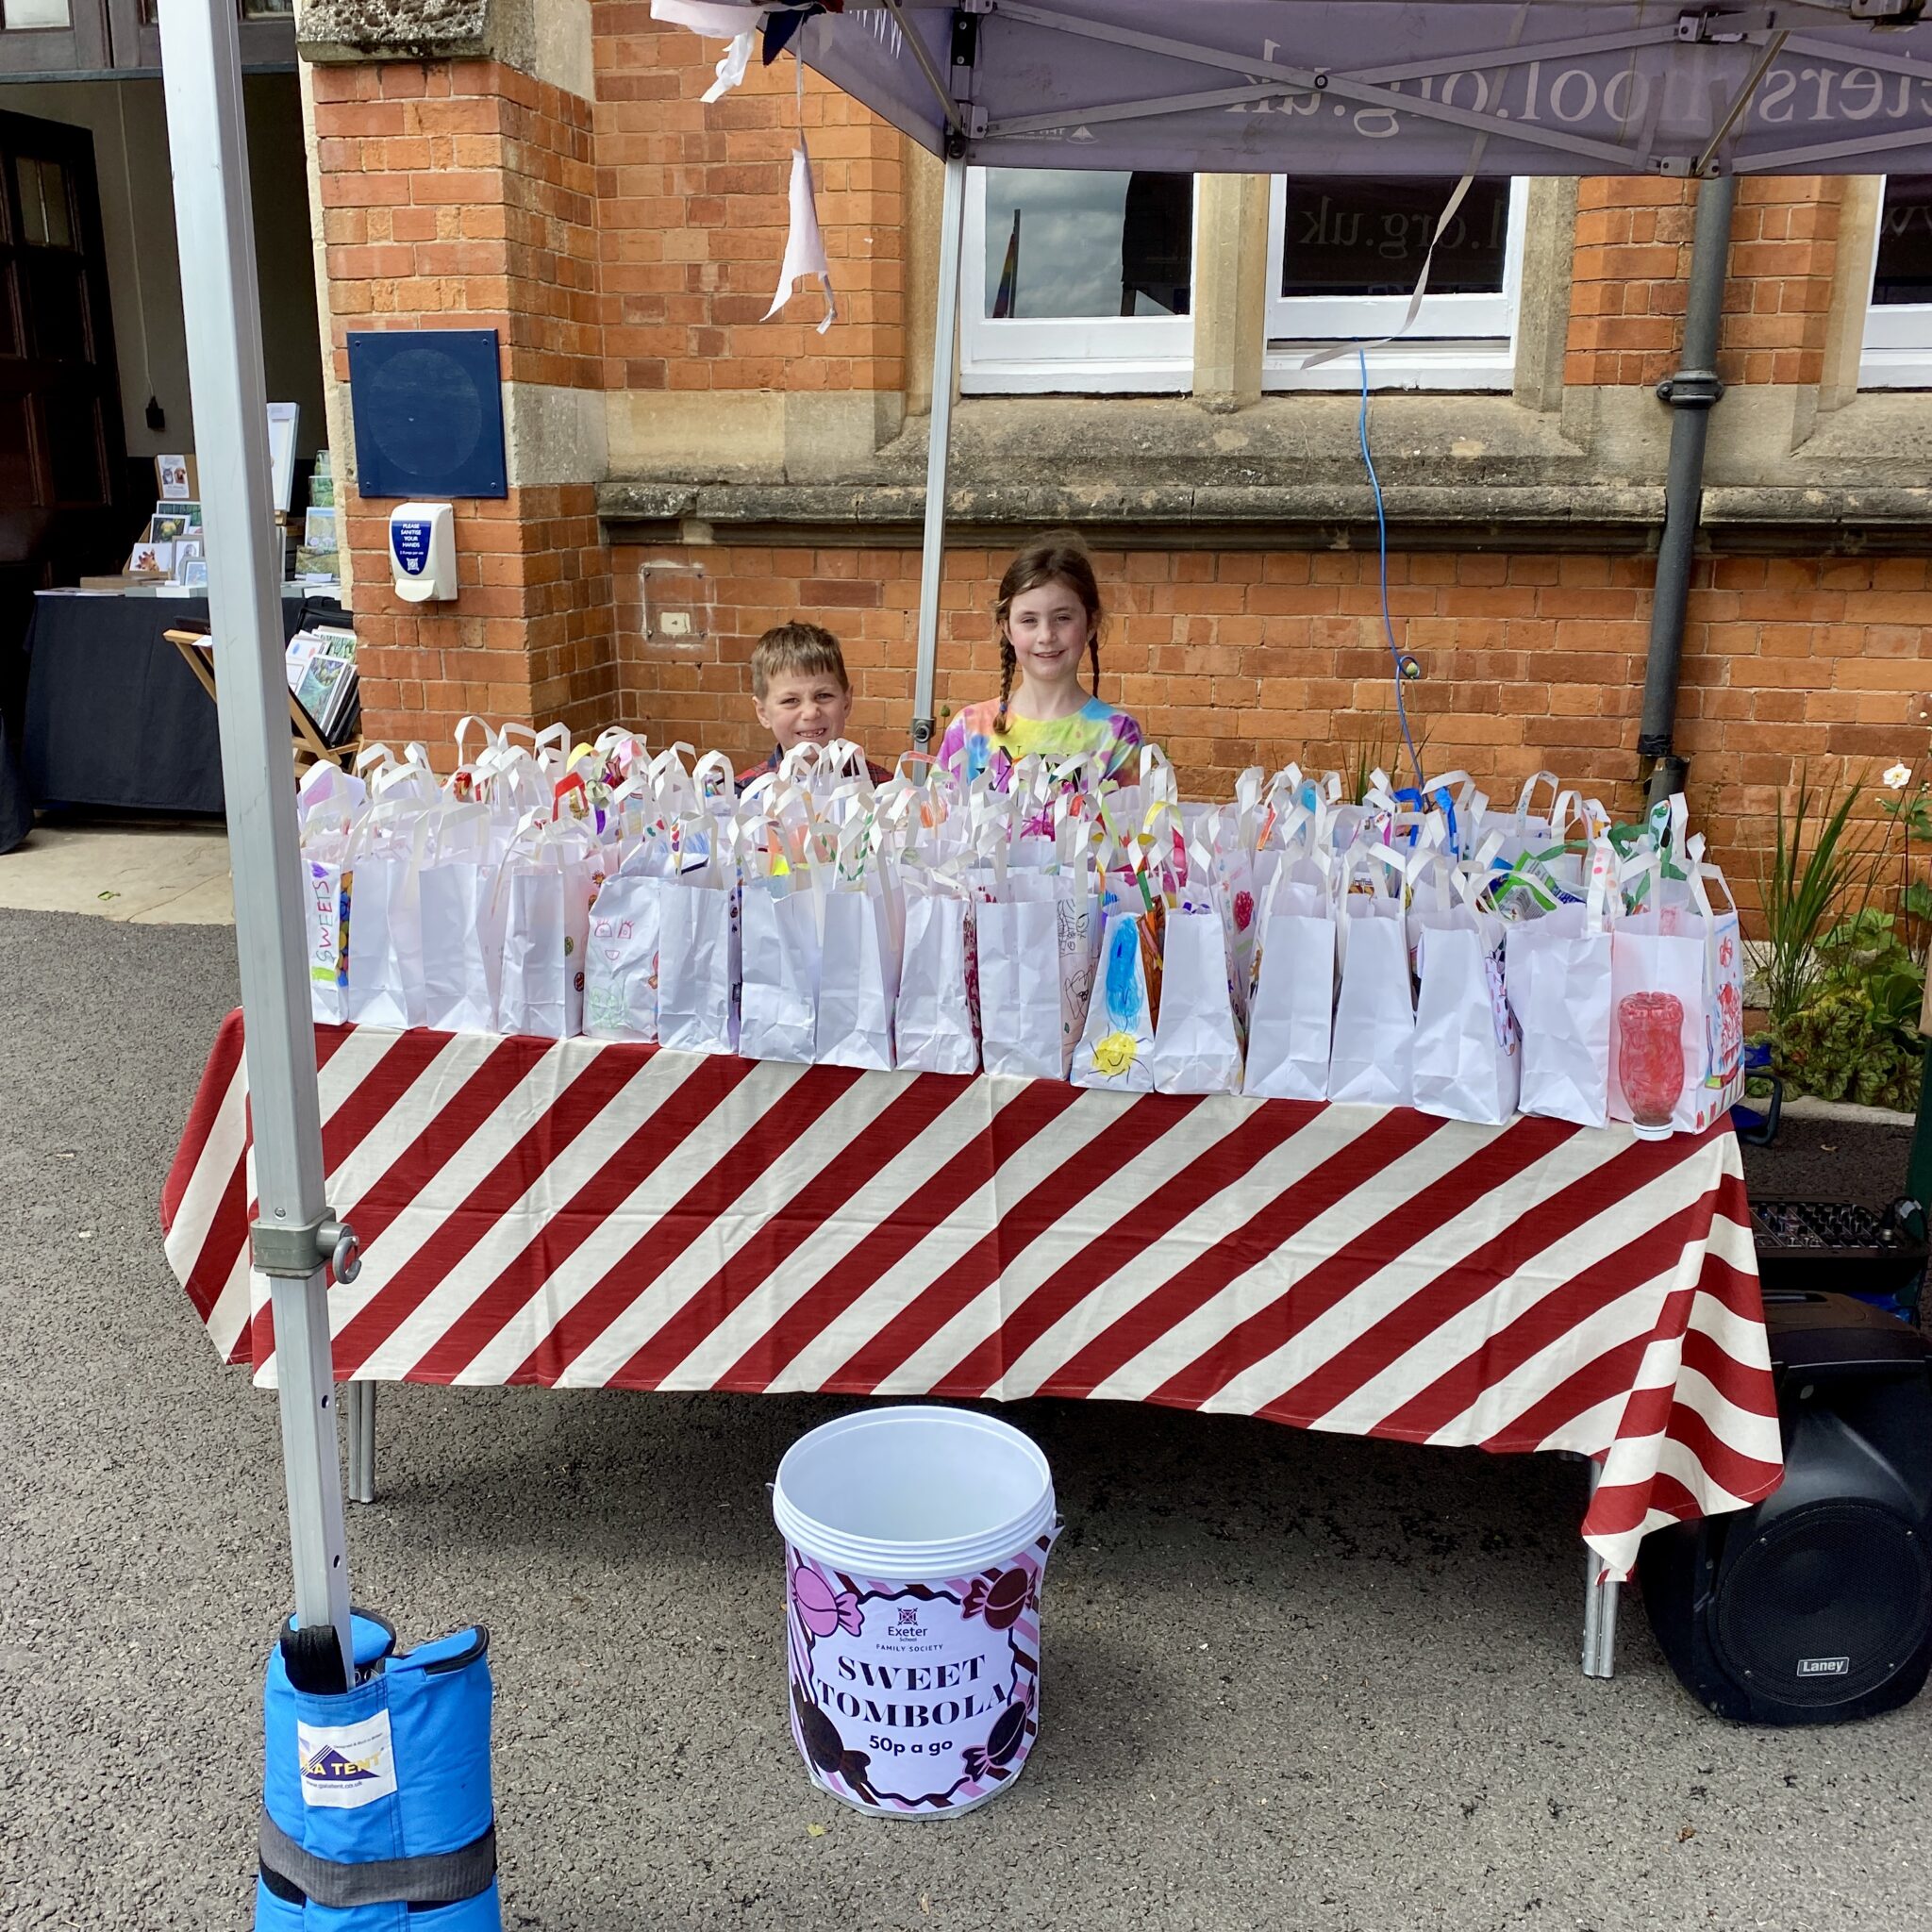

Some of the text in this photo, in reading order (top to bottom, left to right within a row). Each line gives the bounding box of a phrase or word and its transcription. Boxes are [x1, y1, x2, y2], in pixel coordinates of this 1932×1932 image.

[312, 879, 336, 964] SWEETS
[887, 1625, 929, 1637] Exeter
[875, 1643, 944, 1653] FAMILY SOCIETY
[837, 1654, 987, 1691] SWEET
[1802, 1660, 1845, 1673] Laney
[816, 1677, 1009, 1728] TOMBOLA
[869, 1734, 954, 1757] 50p a go
[330, 1750, 382, 1775] TENT
